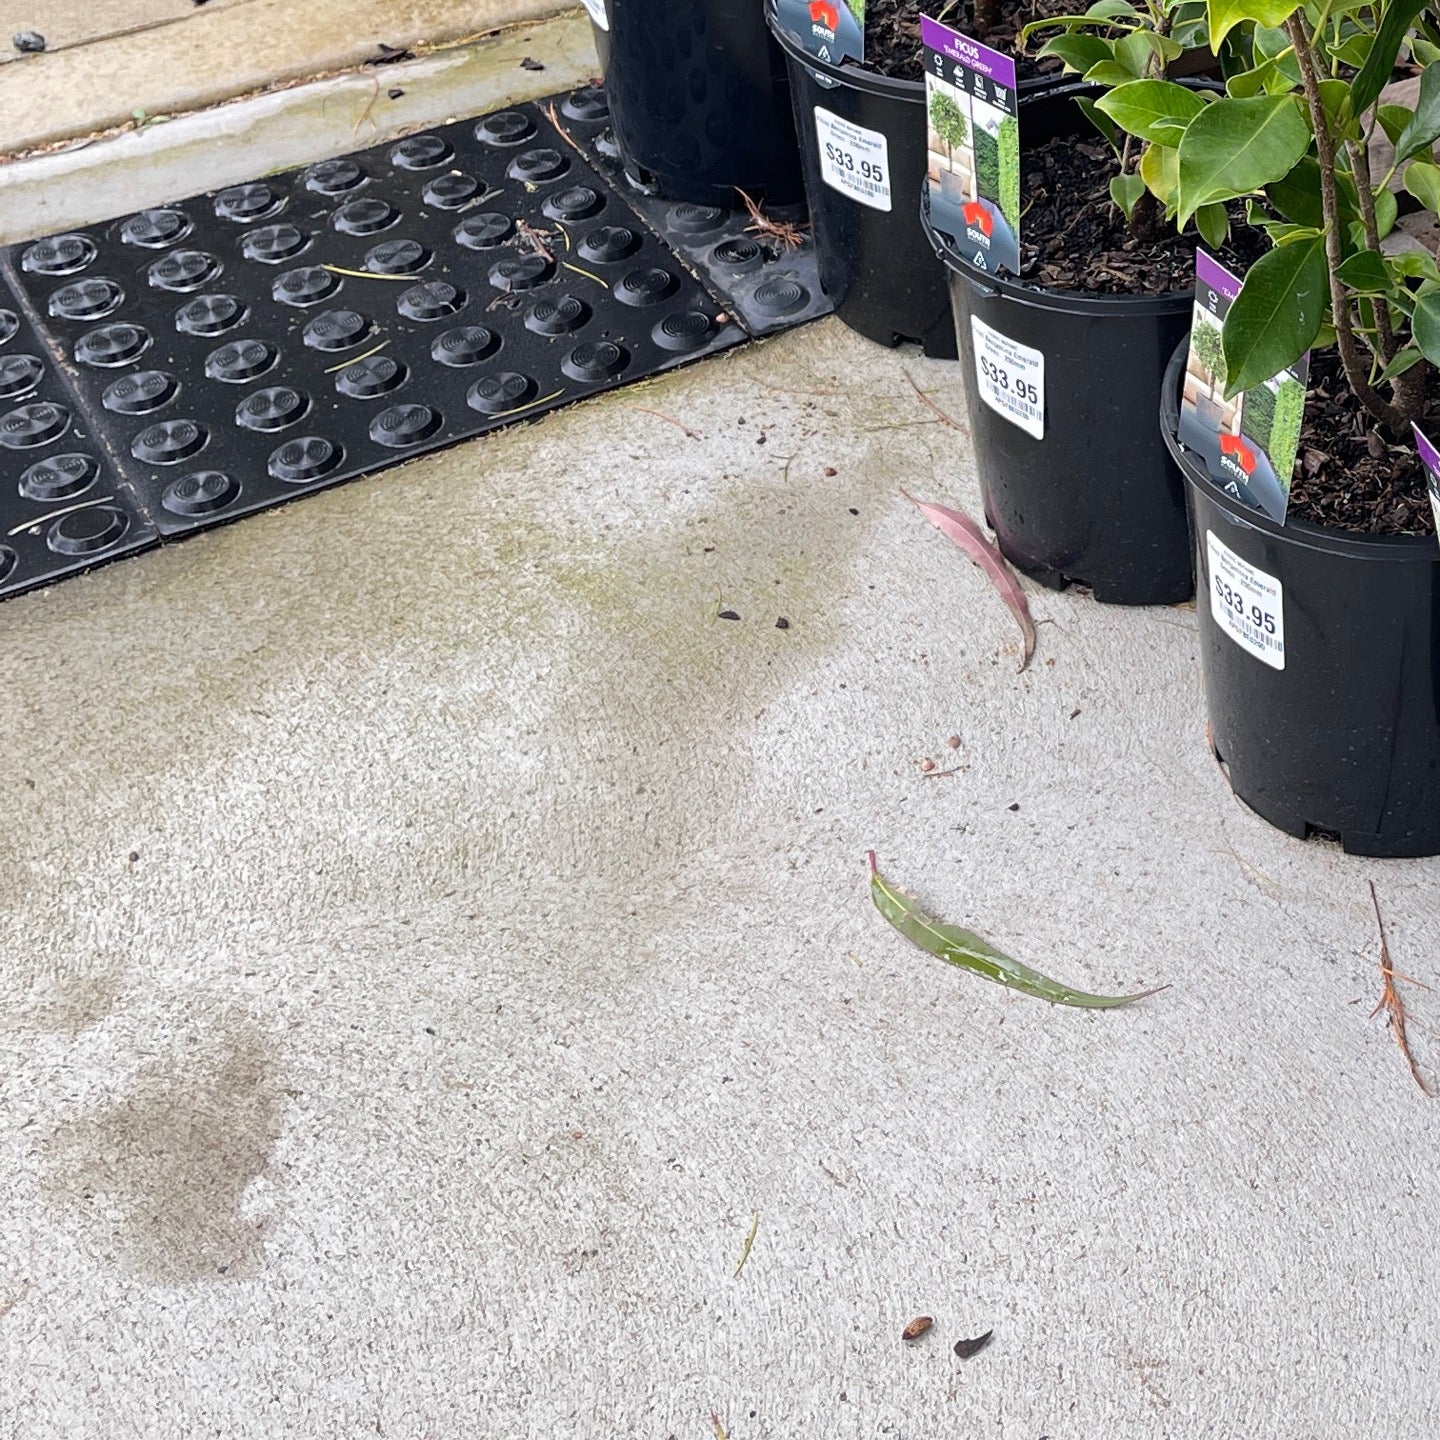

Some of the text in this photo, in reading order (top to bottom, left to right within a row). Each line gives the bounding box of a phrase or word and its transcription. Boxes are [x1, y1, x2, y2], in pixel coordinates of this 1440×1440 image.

[954, 38, 979, 59] FICUS
[826, 142, 883, 182] $33.95
[981, 356, 1038, 405] $33.95
[1215, 574, 1276, 635] $33.95
